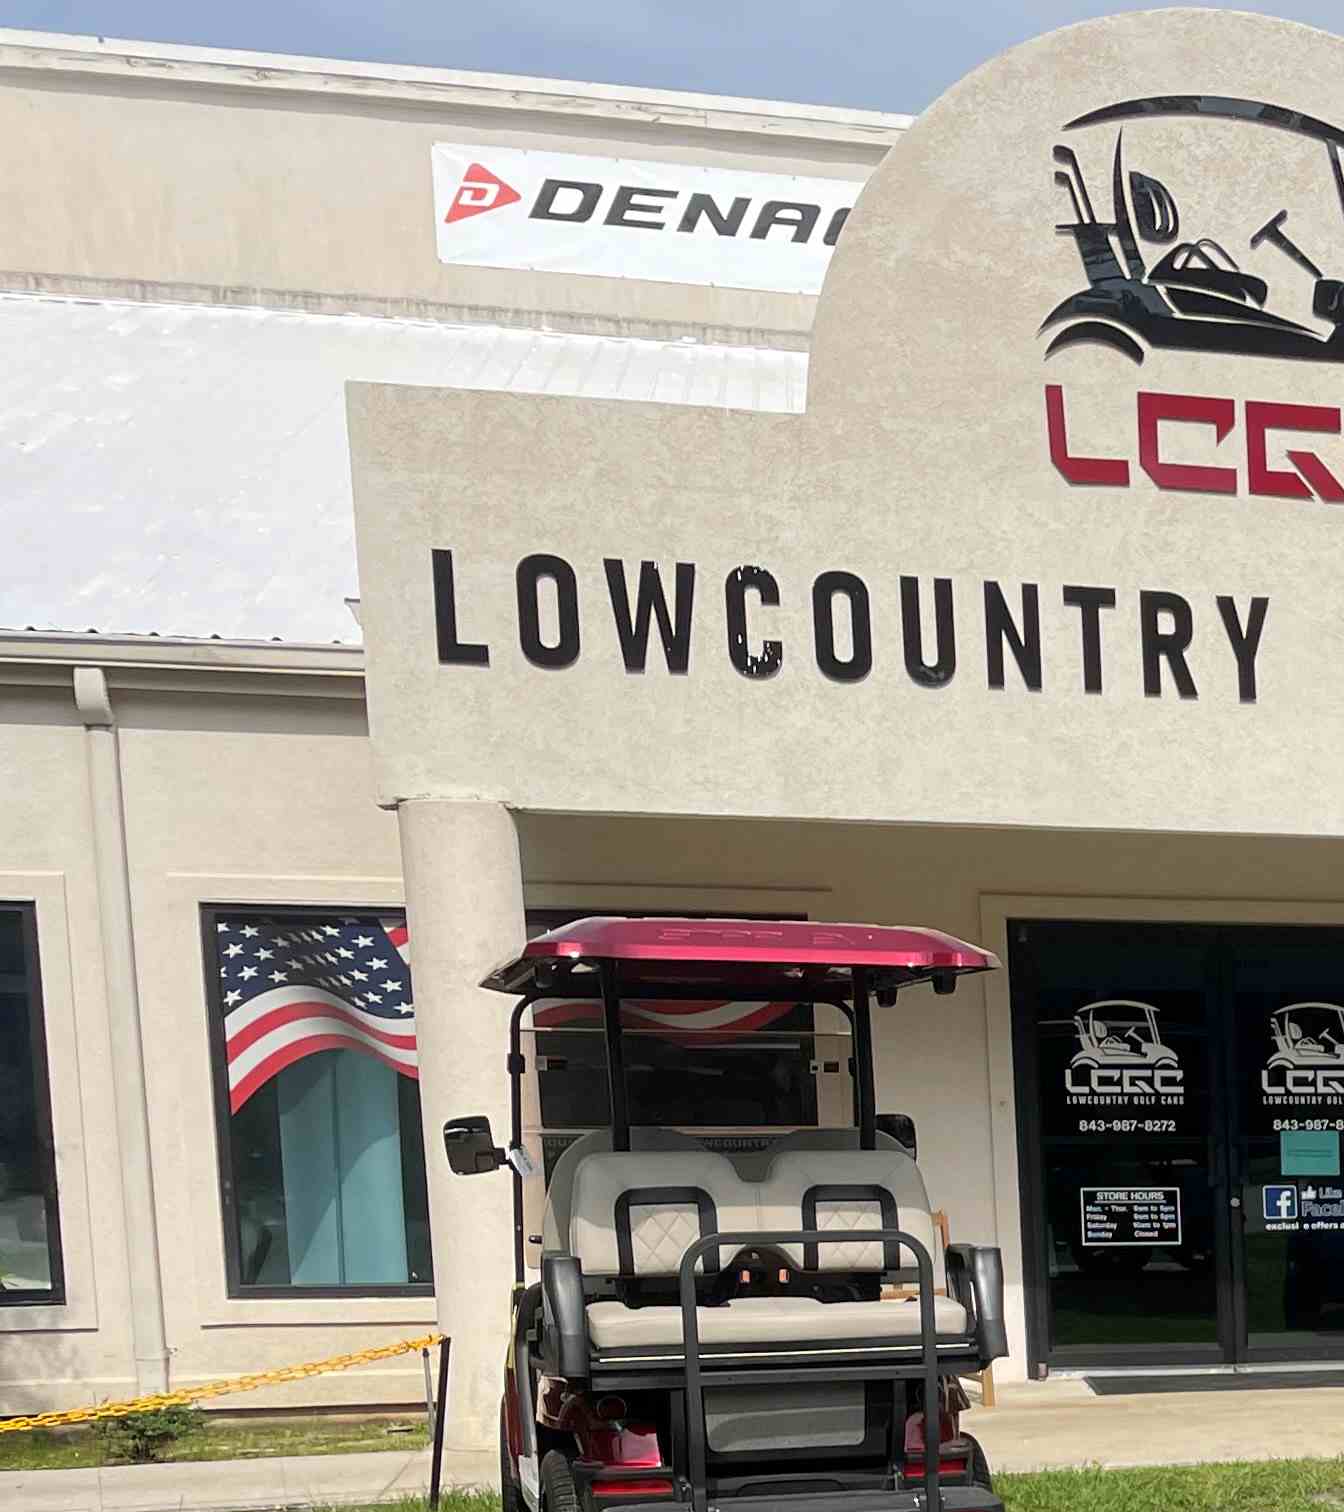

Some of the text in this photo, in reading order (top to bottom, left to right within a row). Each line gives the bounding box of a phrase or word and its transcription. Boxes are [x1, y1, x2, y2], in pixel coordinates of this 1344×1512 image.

[431, 548, 1270, 704] LOWCOUNTRY
[1065, 1069, 1184, 1093] LCGC
[1066, 1096, 1129, 1105] LOWCOUNTRY
[1079, 1120, 1176, 1132] 843-987-8272
[1096, 1191, 1165, 1201] STORE HOURS
[1319, 1187, 1342, 1199] Like
[1265, 1221, 1309, 1231] exclusie
[1311, 1221, 1338, 1230] offers
